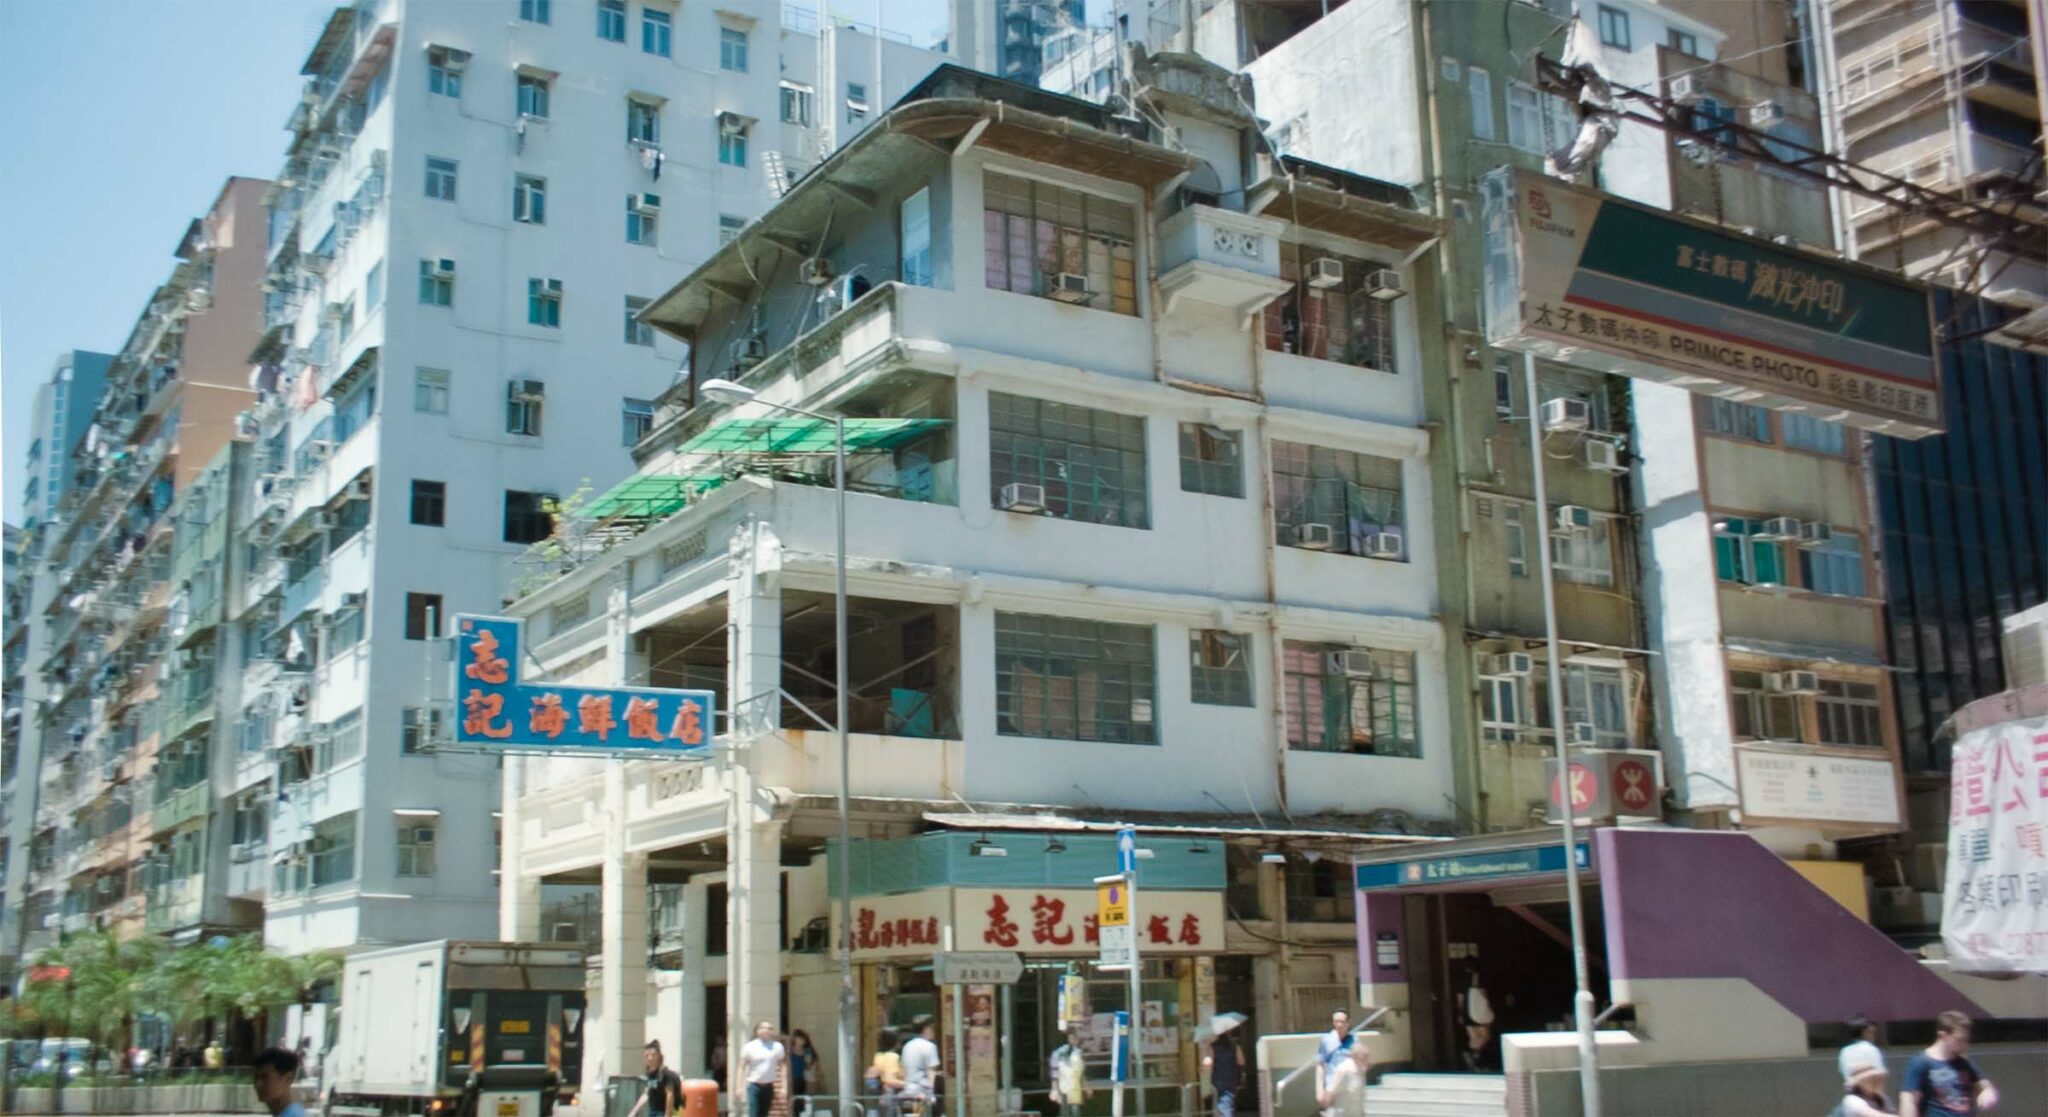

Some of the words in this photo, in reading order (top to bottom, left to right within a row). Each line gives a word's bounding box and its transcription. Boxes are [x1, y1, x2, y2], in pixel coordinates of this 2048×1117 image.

[1669, 335, 1745, 370] PRINCE
[1752, 355, 1819, 389] PHOTO
[984, 894, 1200, 948] 志記海飯店
